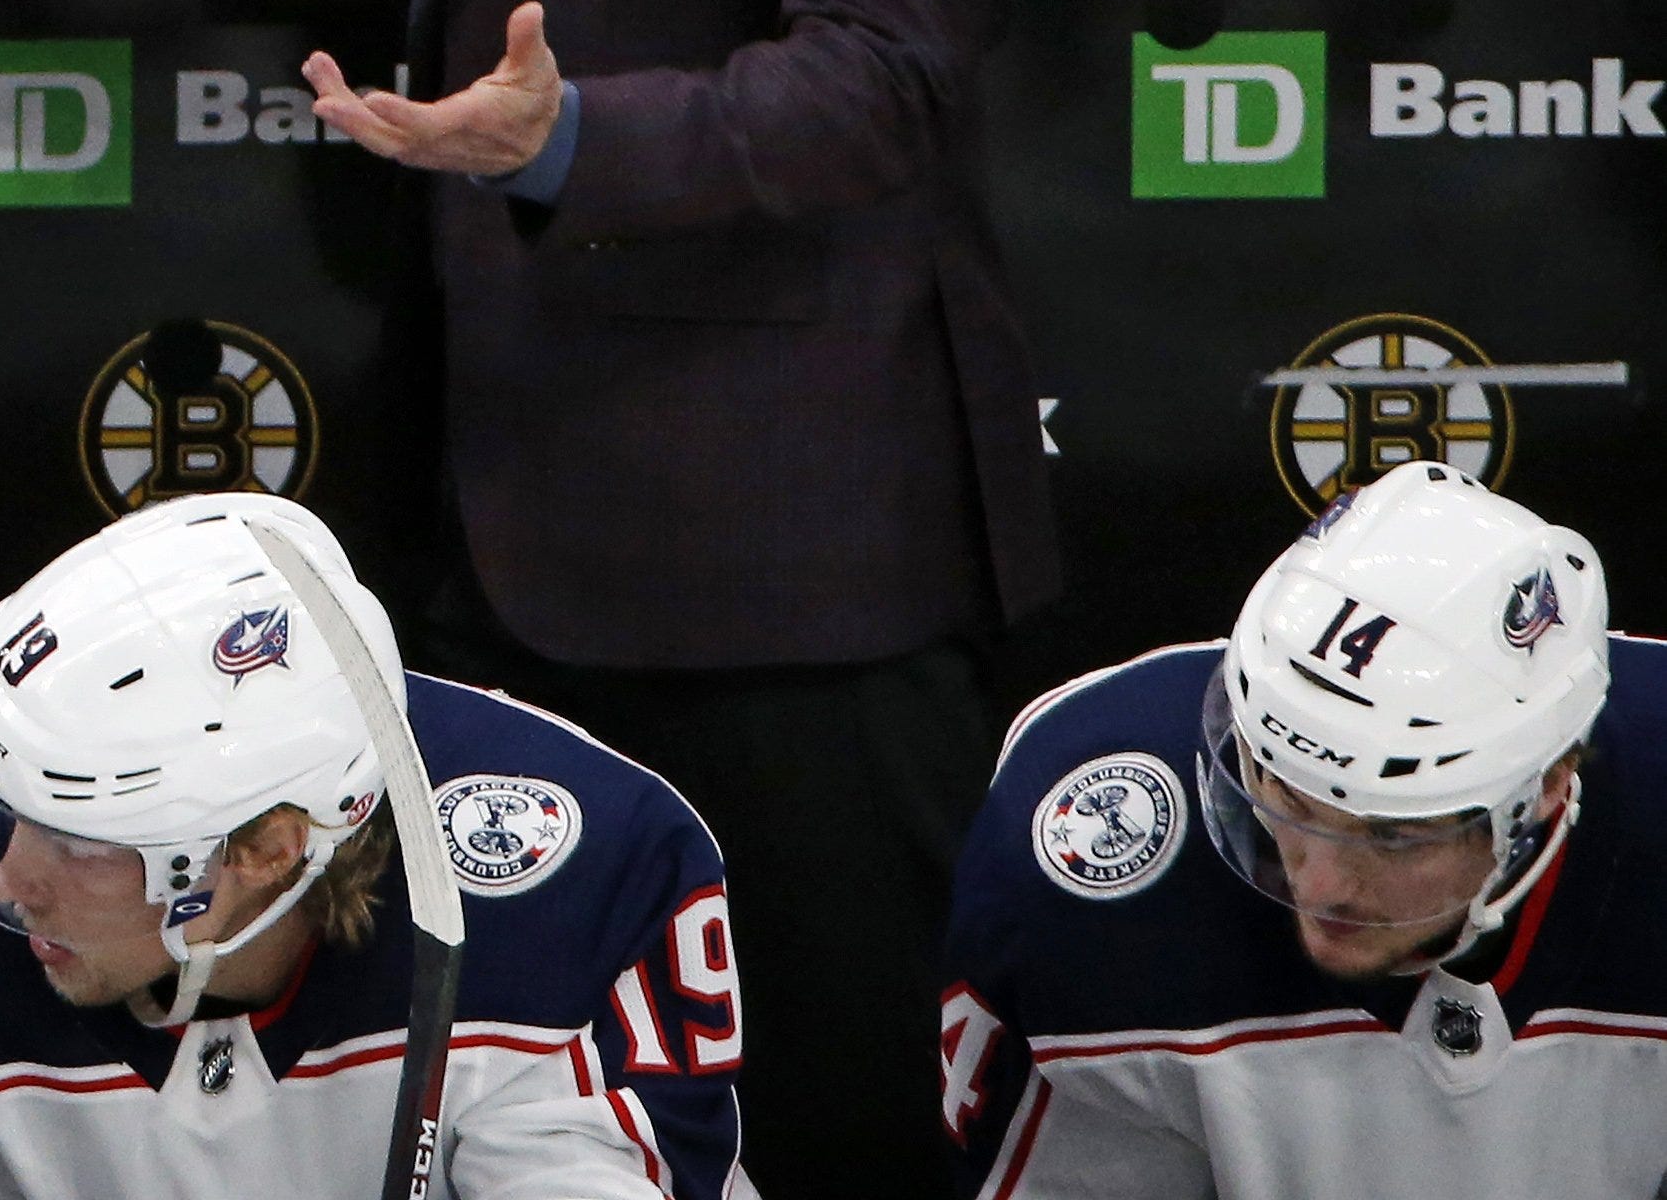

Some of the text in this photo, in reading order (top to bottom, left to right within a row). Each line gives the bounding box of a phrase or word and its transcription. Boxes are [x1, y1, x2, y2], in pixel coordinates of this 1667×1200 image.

[177, 63, 410, 144] Ba
[1151, 57, 1666, 163] TD Bank
[1309, 597, 1398, 680] 14
[1260, 711, 1356, 768] CCM
[609, 883, 744, 1076] 19
[409, 1118, 436, 1200] CCM
